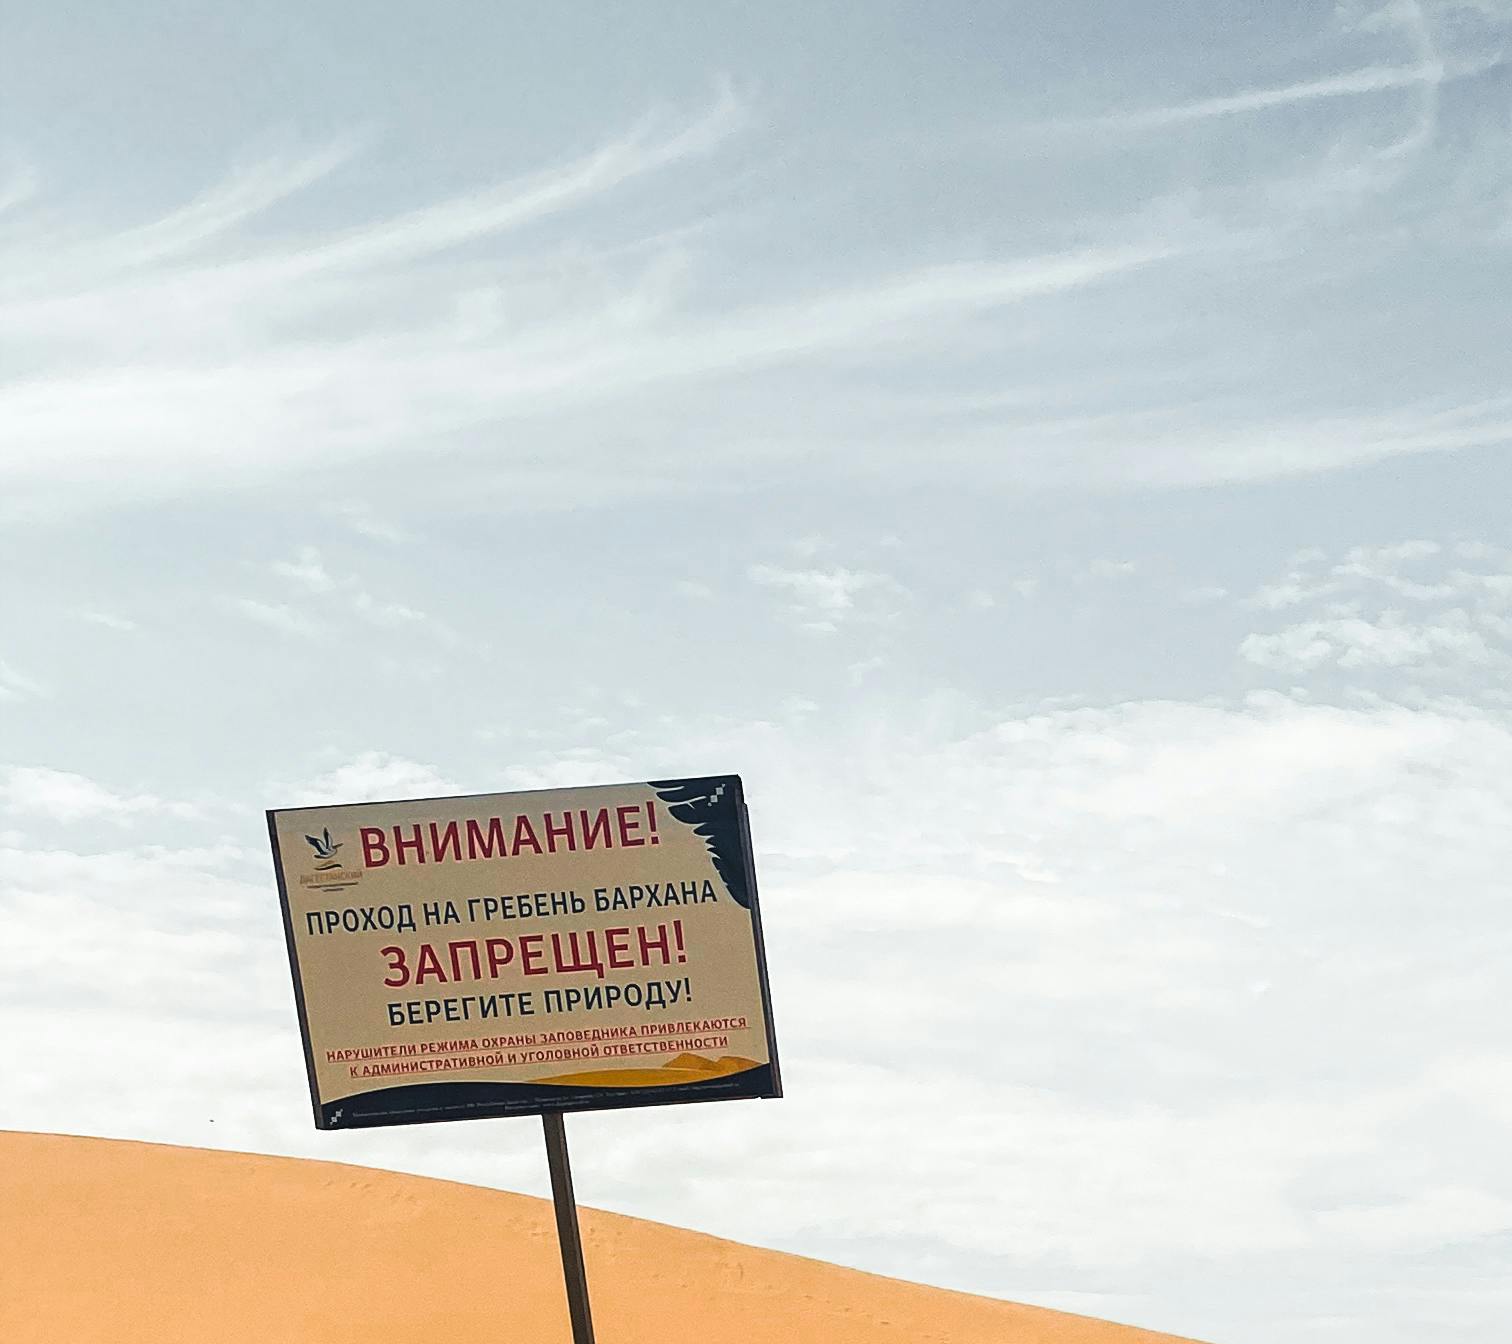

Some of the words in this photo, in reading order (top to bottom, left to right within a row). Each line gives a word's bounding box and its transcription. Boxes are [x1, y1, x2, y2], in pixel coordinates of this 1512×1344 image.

[359, 800, 660, 869] ВНИМАНИЕ!
[306, 904, 416, 935] ПРОХОД
[423, 901, 461, 926] НА
[468, 891, 586, 922] ГРЕБЕНЬ
[594, 879, 718, 912] БАРХАНА
[380, 919, 688, 988] ЗАПРЕЩЕН!
[387, 992, 535, 1026] БЕРЕГИТЕ
[544, 977, 692, 1014] ПРИРОДУ!
[326, 1045, 417, 1062] НАРУШИТЕЛИ
[421, 1039, 478, 1054] РЕЖИМА
[482, 1035, 536, 1048] ОХРАНЫ
[540, 1026, 637, 1043] ЗАПОВЕДНИКА
[641, 1017, 747, 1036] ПРИВЛЕКАЮТСЯ
[350, 1066, 358, 1077] К
[363, 1052, 503, 1076] АДМИНИСТРАТИВНОЙ
[507, 1055, 517, 1065] И
[521, 1044, 600, 1063] УГОЛОВНОЙ
[603, 1036, 728, 1056] ОТВЕТСТВЕННОСТИ
